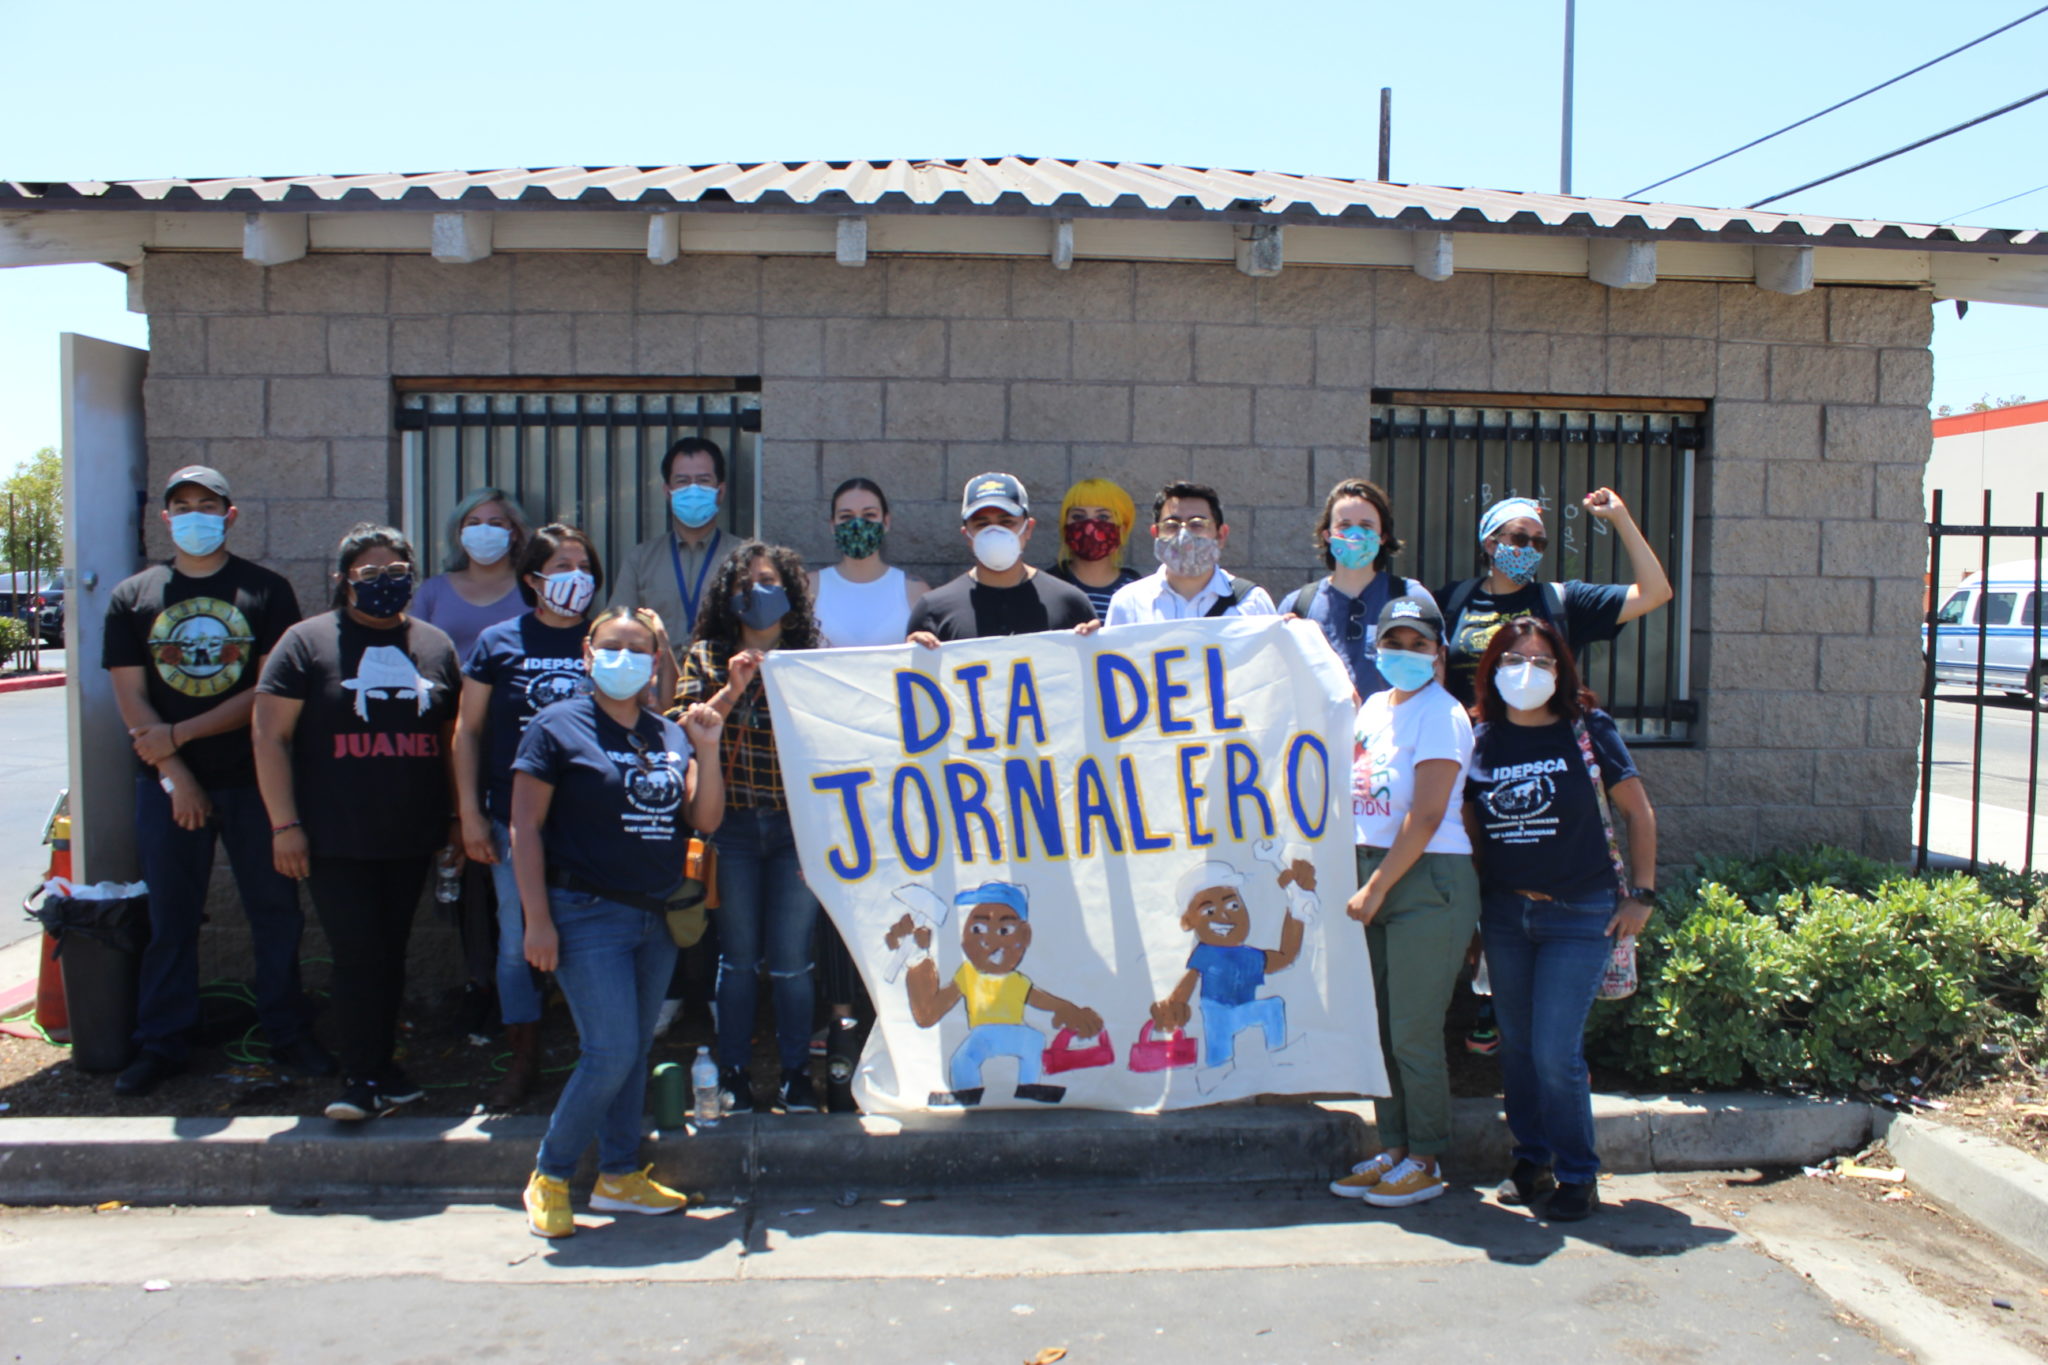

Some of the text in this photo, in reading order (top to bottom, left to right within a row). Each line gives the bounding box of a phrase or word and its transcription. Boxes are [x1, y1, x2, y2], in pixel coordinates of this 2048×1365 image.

[523, 657, 587, 671] IDEPSC
[894, 643, 1245, 757] DIA DEL
[333, 732, 439, 759] JUANES
[606, 750, 682, 765] IDESC
[1493, 758, 1568, 781] IDEPSCA
[810, 730, 1331, 884] JORNALERO
